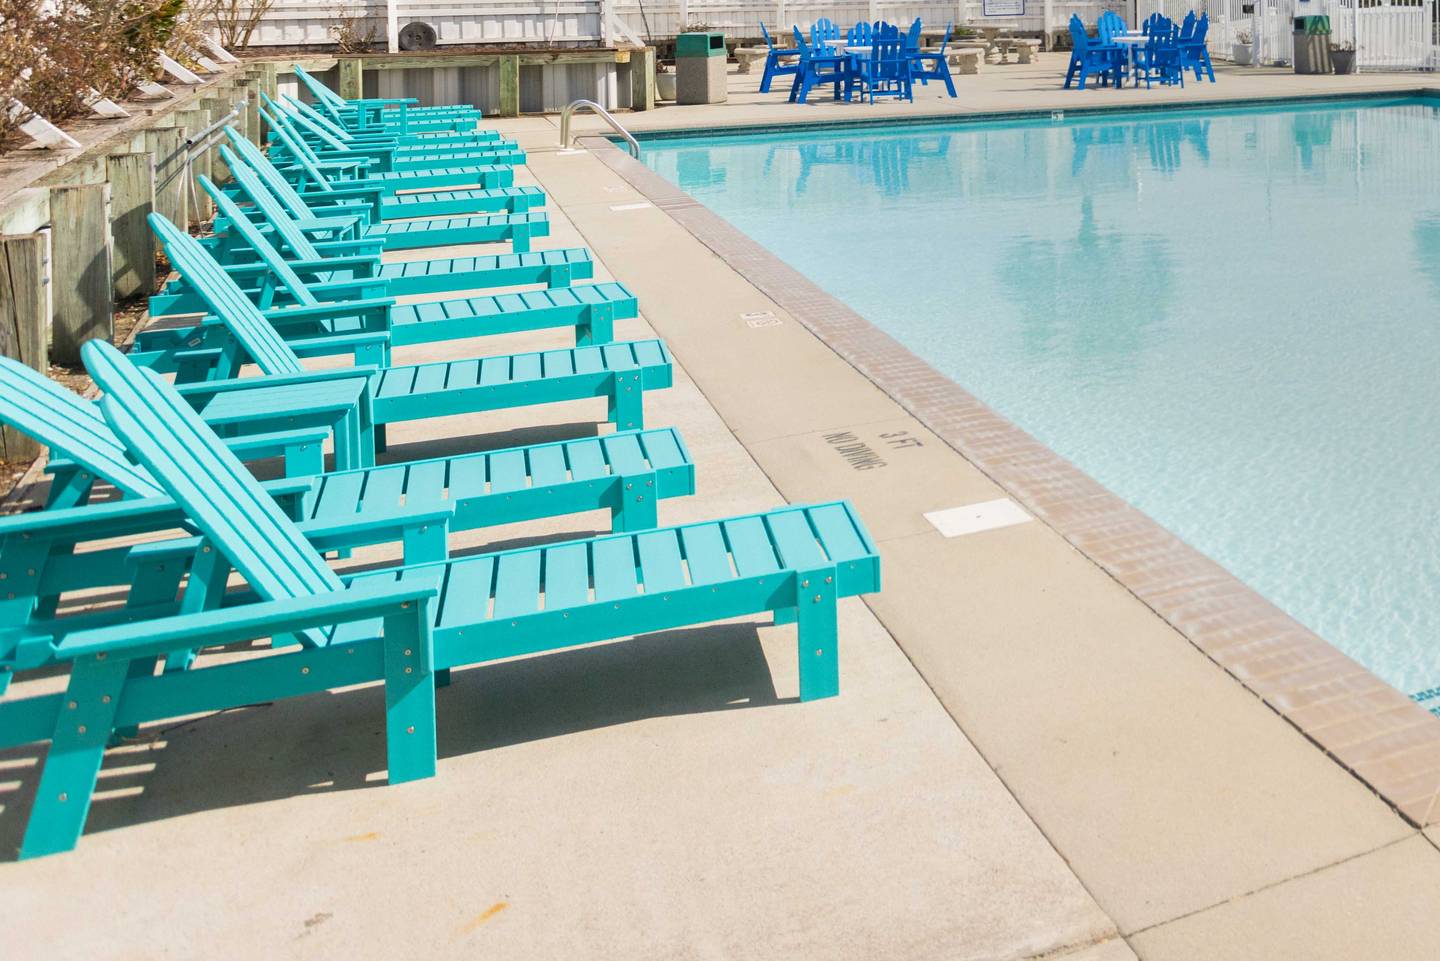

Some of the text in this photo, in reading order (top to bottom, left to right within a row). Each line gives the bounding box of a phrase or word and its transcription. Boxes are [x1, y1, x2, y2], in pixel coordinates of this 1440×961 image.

[822, 431, 888, 472] NO DIVING
[887, 436, 924, 450] FT
